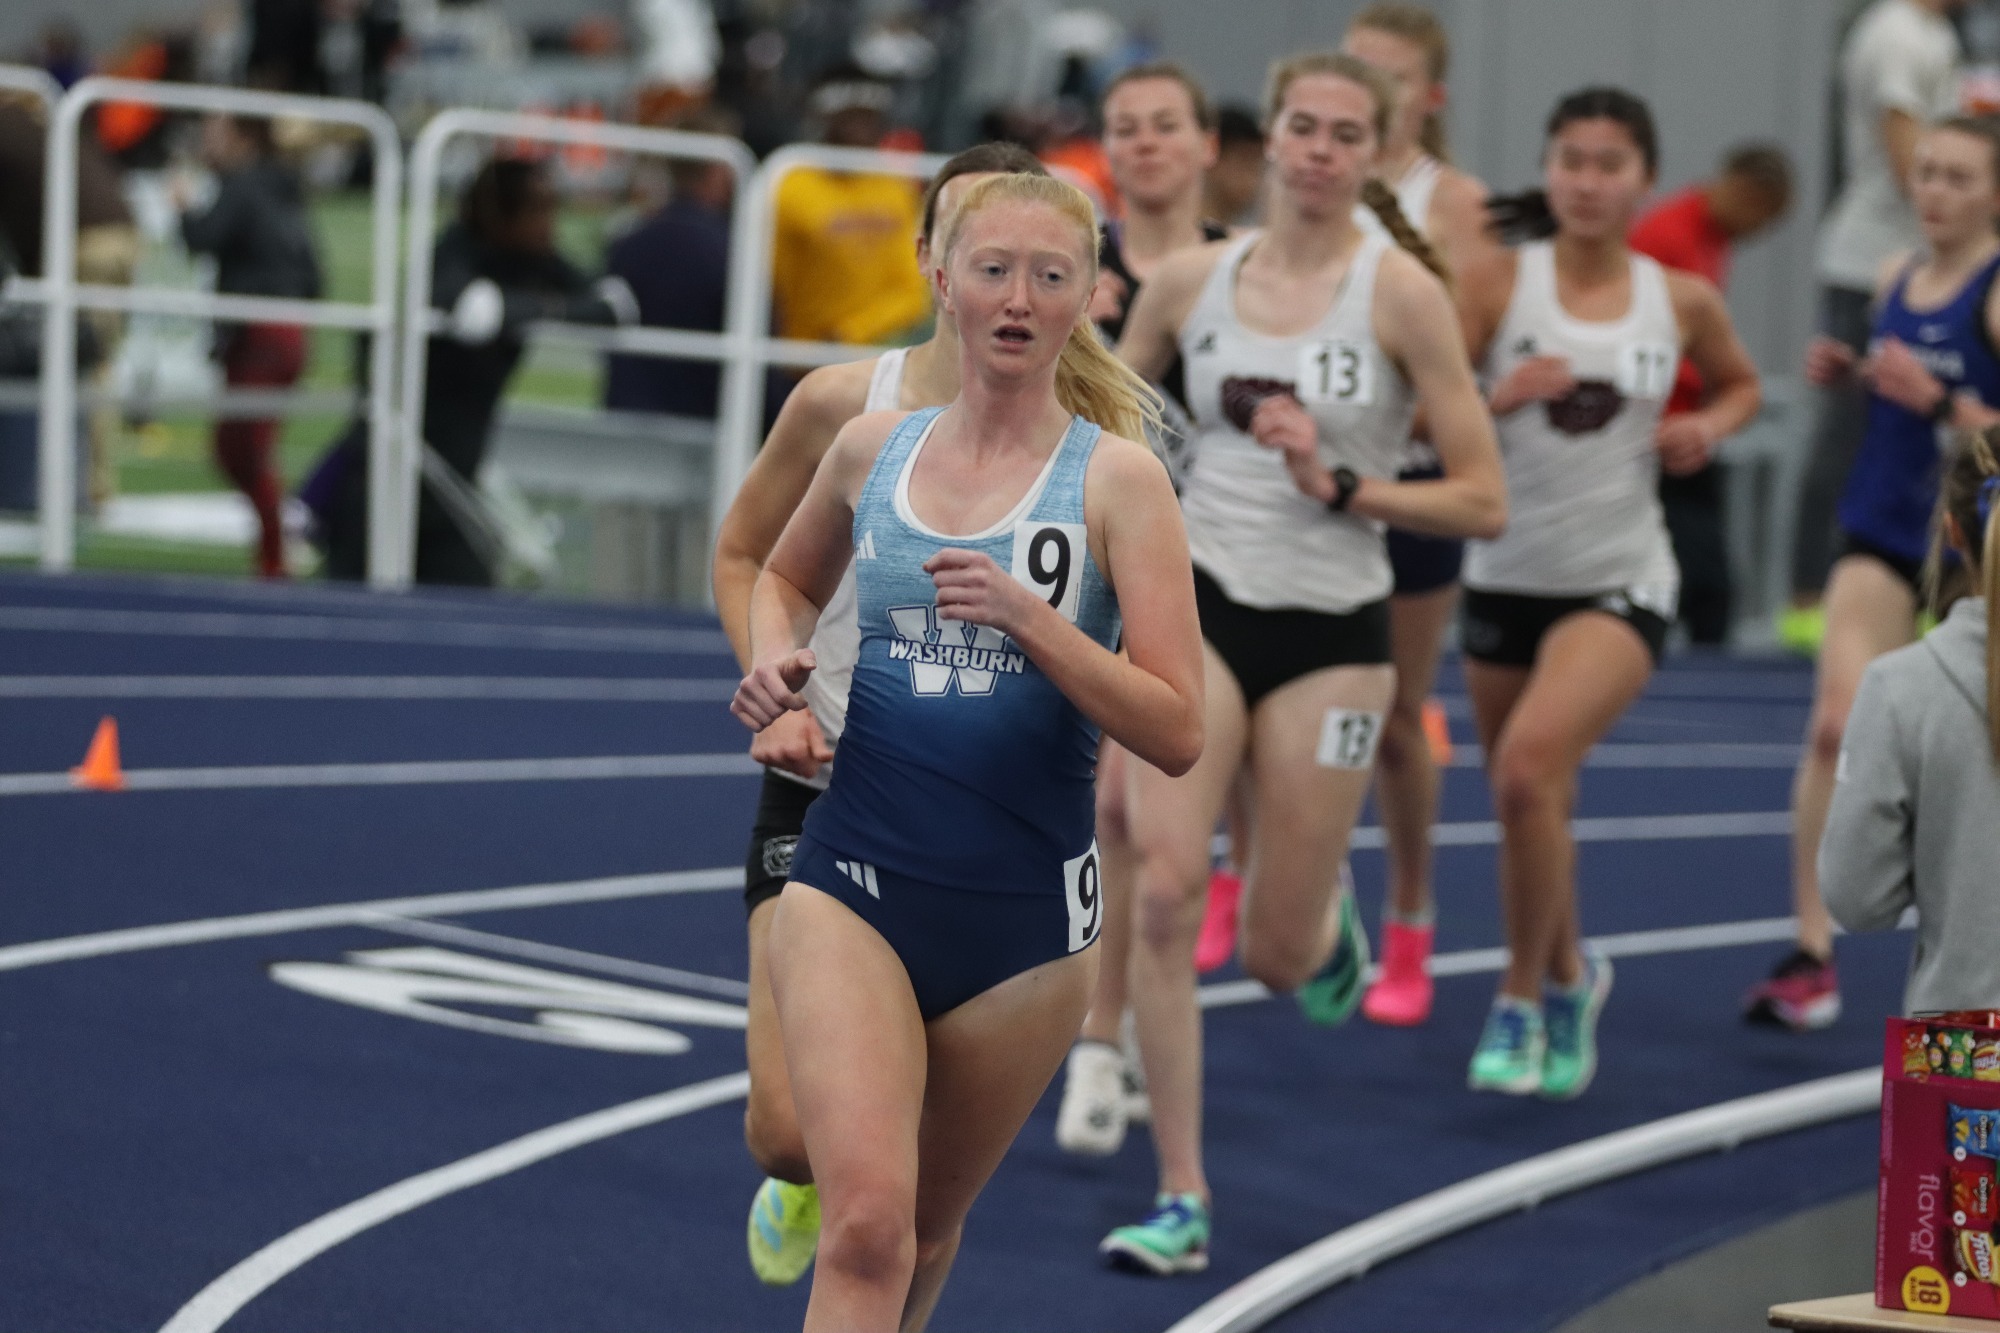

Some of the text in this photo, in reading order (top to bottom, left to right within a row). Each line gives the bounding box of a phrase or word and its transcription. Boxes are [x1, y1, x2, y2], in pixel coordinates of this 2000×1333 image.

[1315, 347, 1360, 398] 13
[1028, 527, 1071, 610] 9
[889, 639, 1026, 675] WASHBURN
[1336, 714, 1373, 766] 13
[1078, 853, 1098, 941] 9
[1918, 1173, 1940, 1262] flavor
[1970, 1232, 1990, 1278] Fritos
[1919, 1279, 1942, 1304] 18
